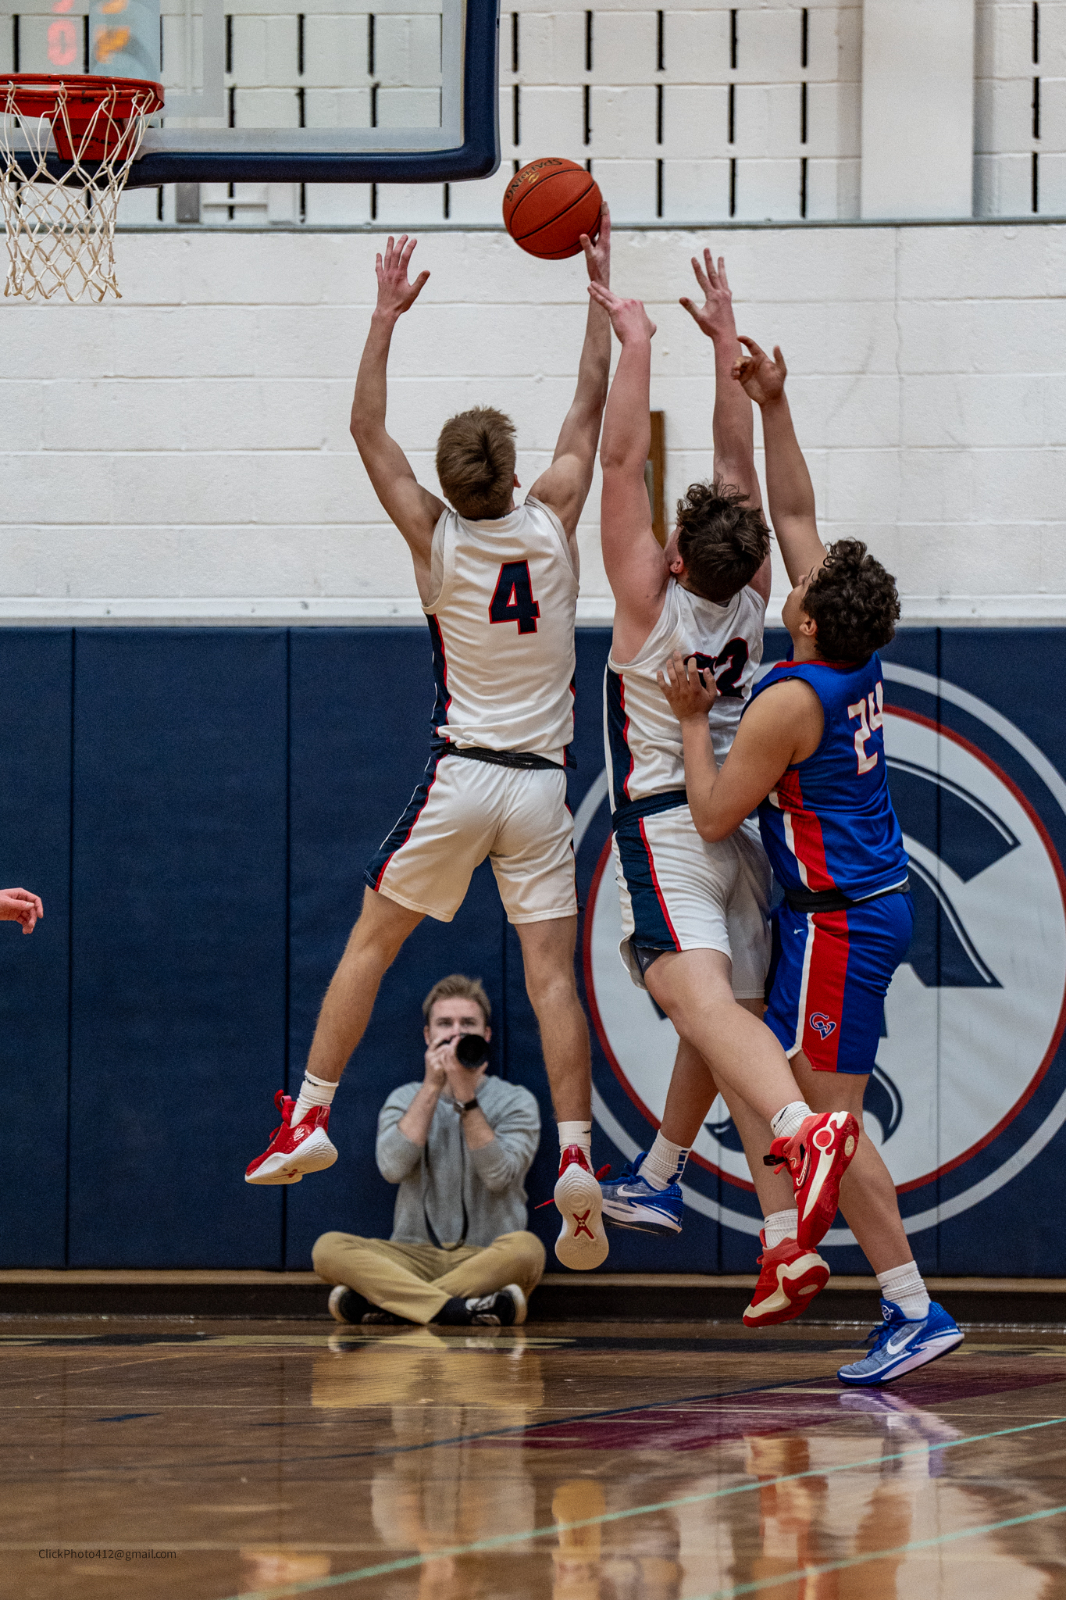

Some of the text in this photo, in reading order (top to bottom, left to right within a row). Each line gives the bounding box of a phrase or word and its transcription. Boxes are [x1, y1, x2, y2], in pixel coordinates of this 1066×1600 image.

[506, 158, 562, 201] SPALDING
[488, 559, 541, 635] 4
[847, 680, 884, 776] 24
